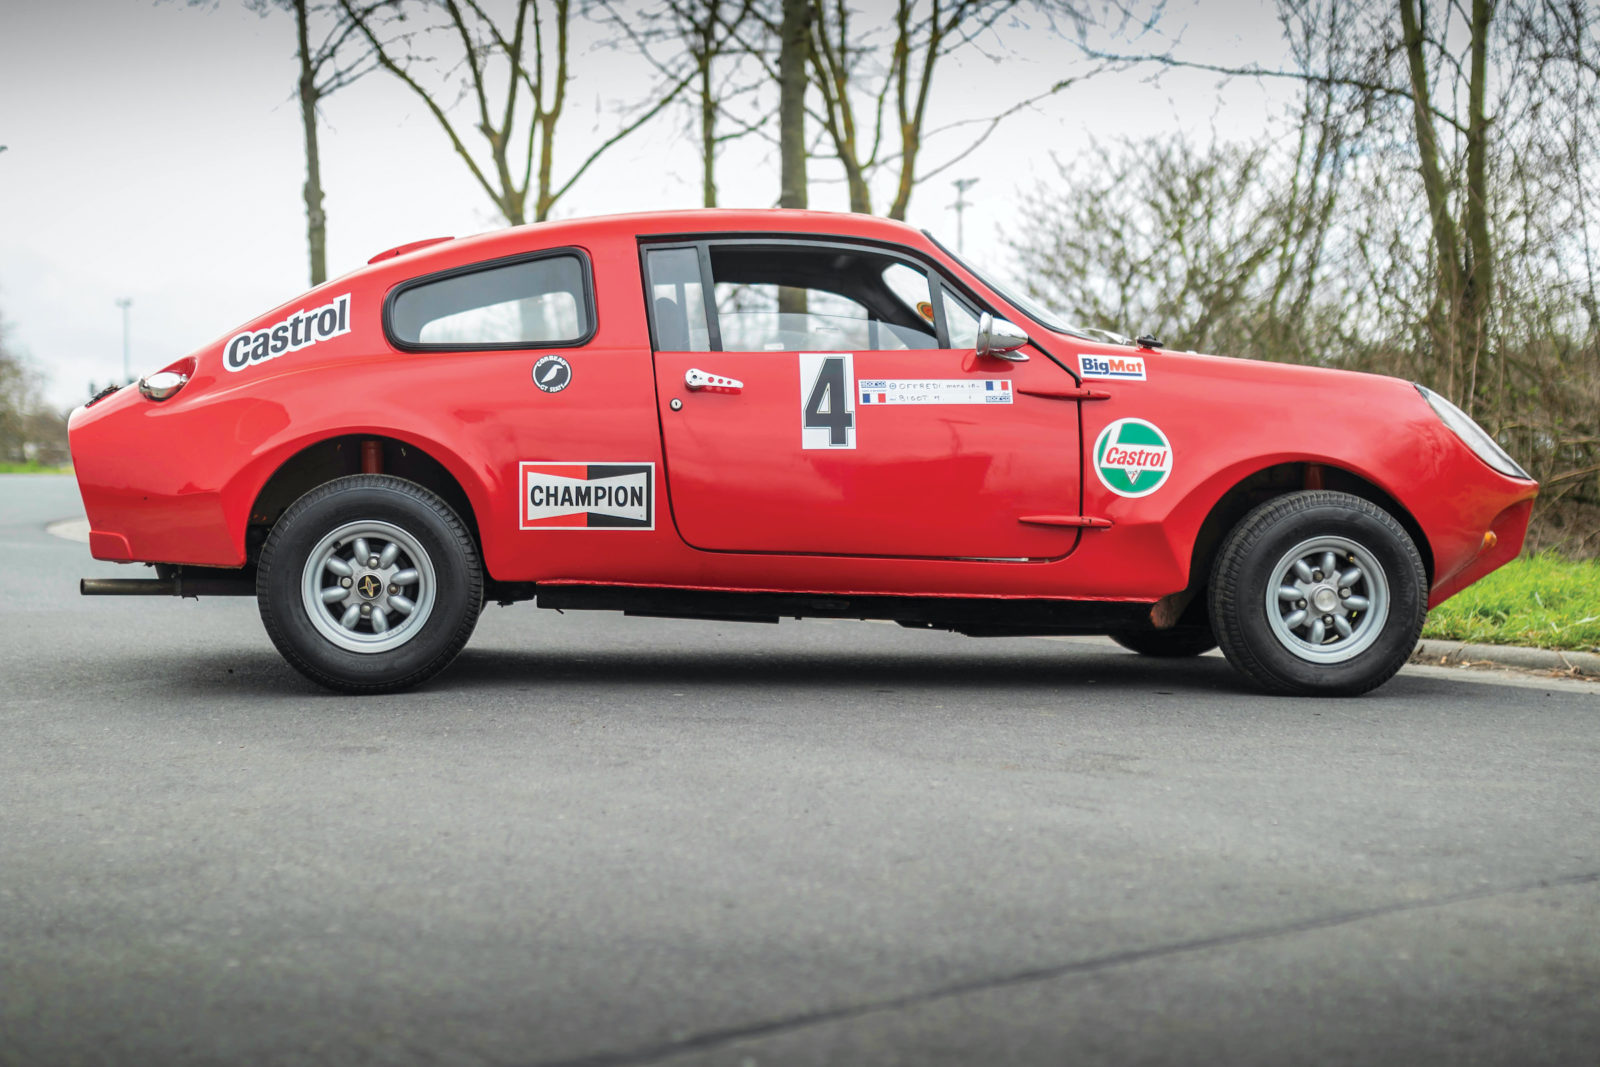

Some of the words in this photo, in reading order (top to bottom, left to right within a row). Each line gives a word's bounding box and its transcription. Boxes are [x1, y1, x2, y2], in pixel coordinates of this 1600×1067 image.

[229, 298, 347, 368] Castrol
[1082, 358, 1142, 375] BigMat
[803, 356, 855, 447] 4
[1106, 447, 1167, 467] Castrol
[531, 485, 643, 507] CHAMPION
